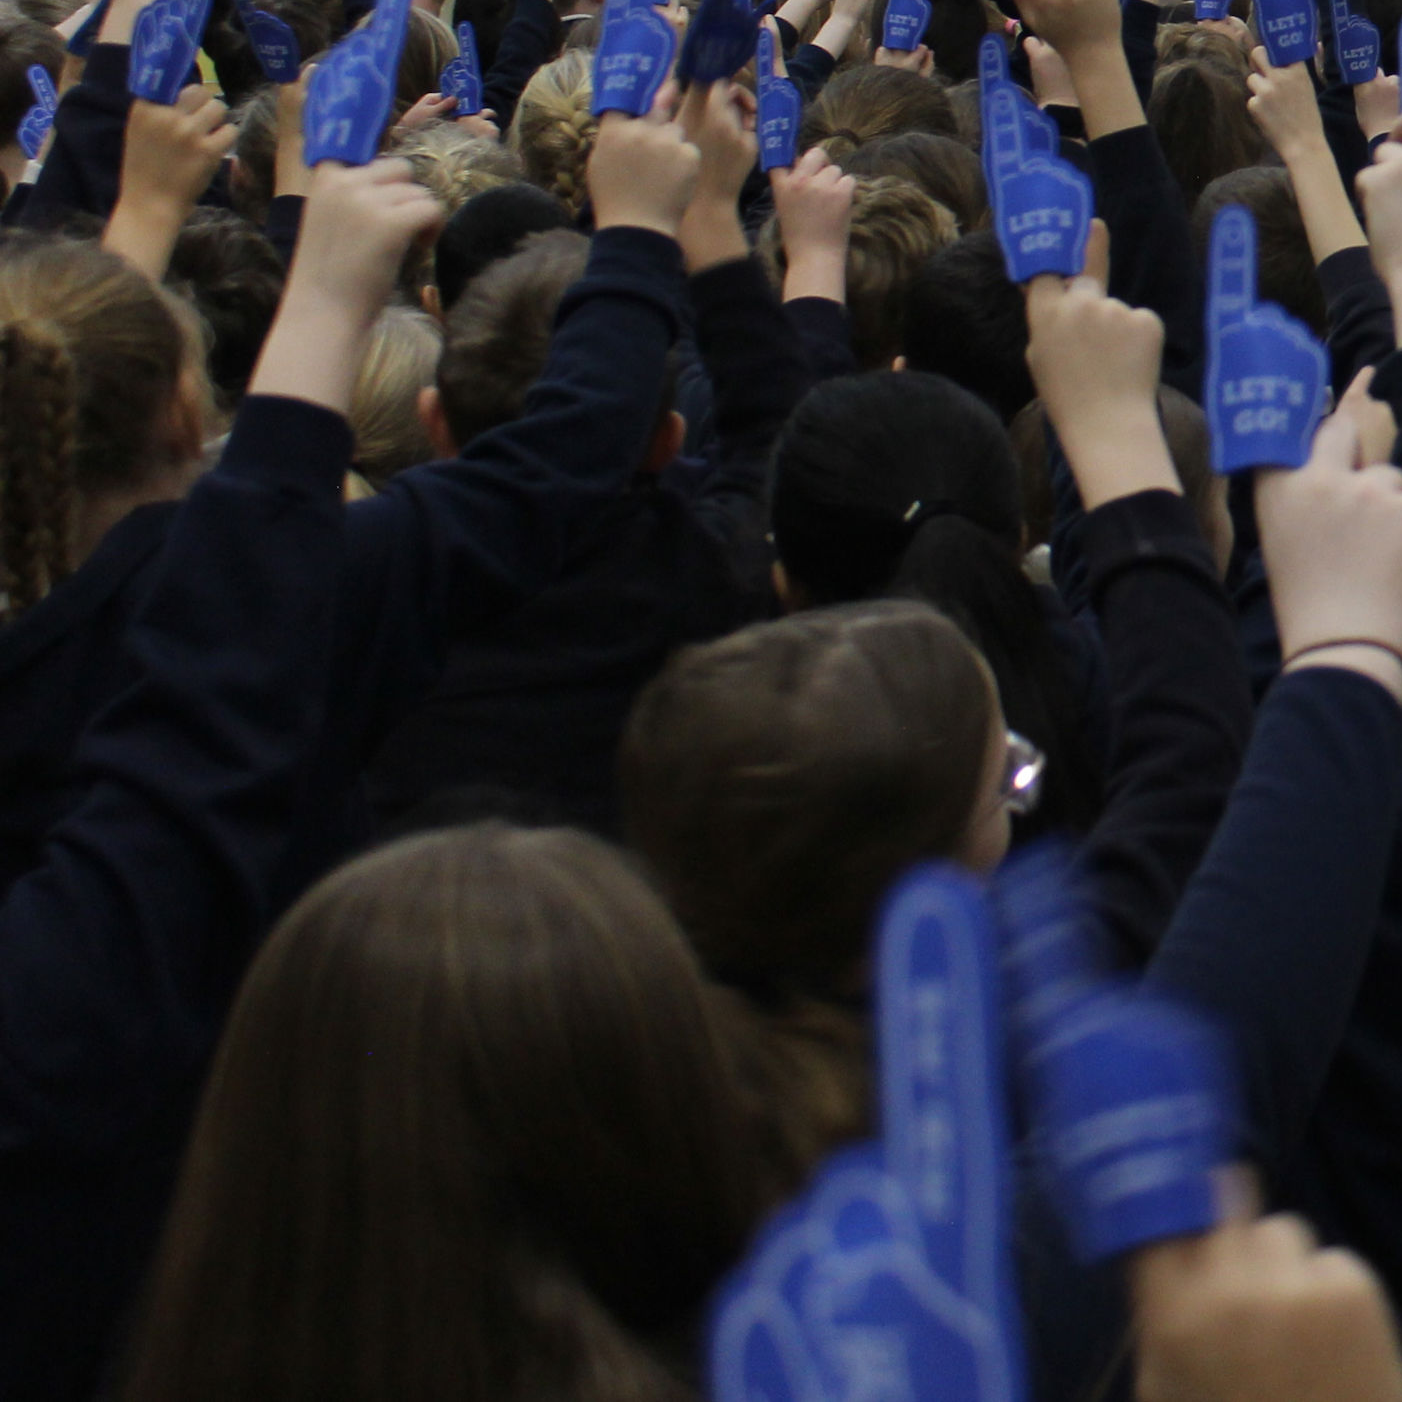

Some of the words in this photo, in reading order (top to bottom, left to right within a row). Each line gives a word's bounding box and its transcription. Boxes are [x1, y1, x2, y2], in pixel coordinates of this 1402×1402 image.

[1268, 13, 1306, 32] LET'S
[1278, 33, 1304, 47] GO!
[1343, 44, 1374, 59] LET'S
[1350, 58, 1371, 70] GO!
